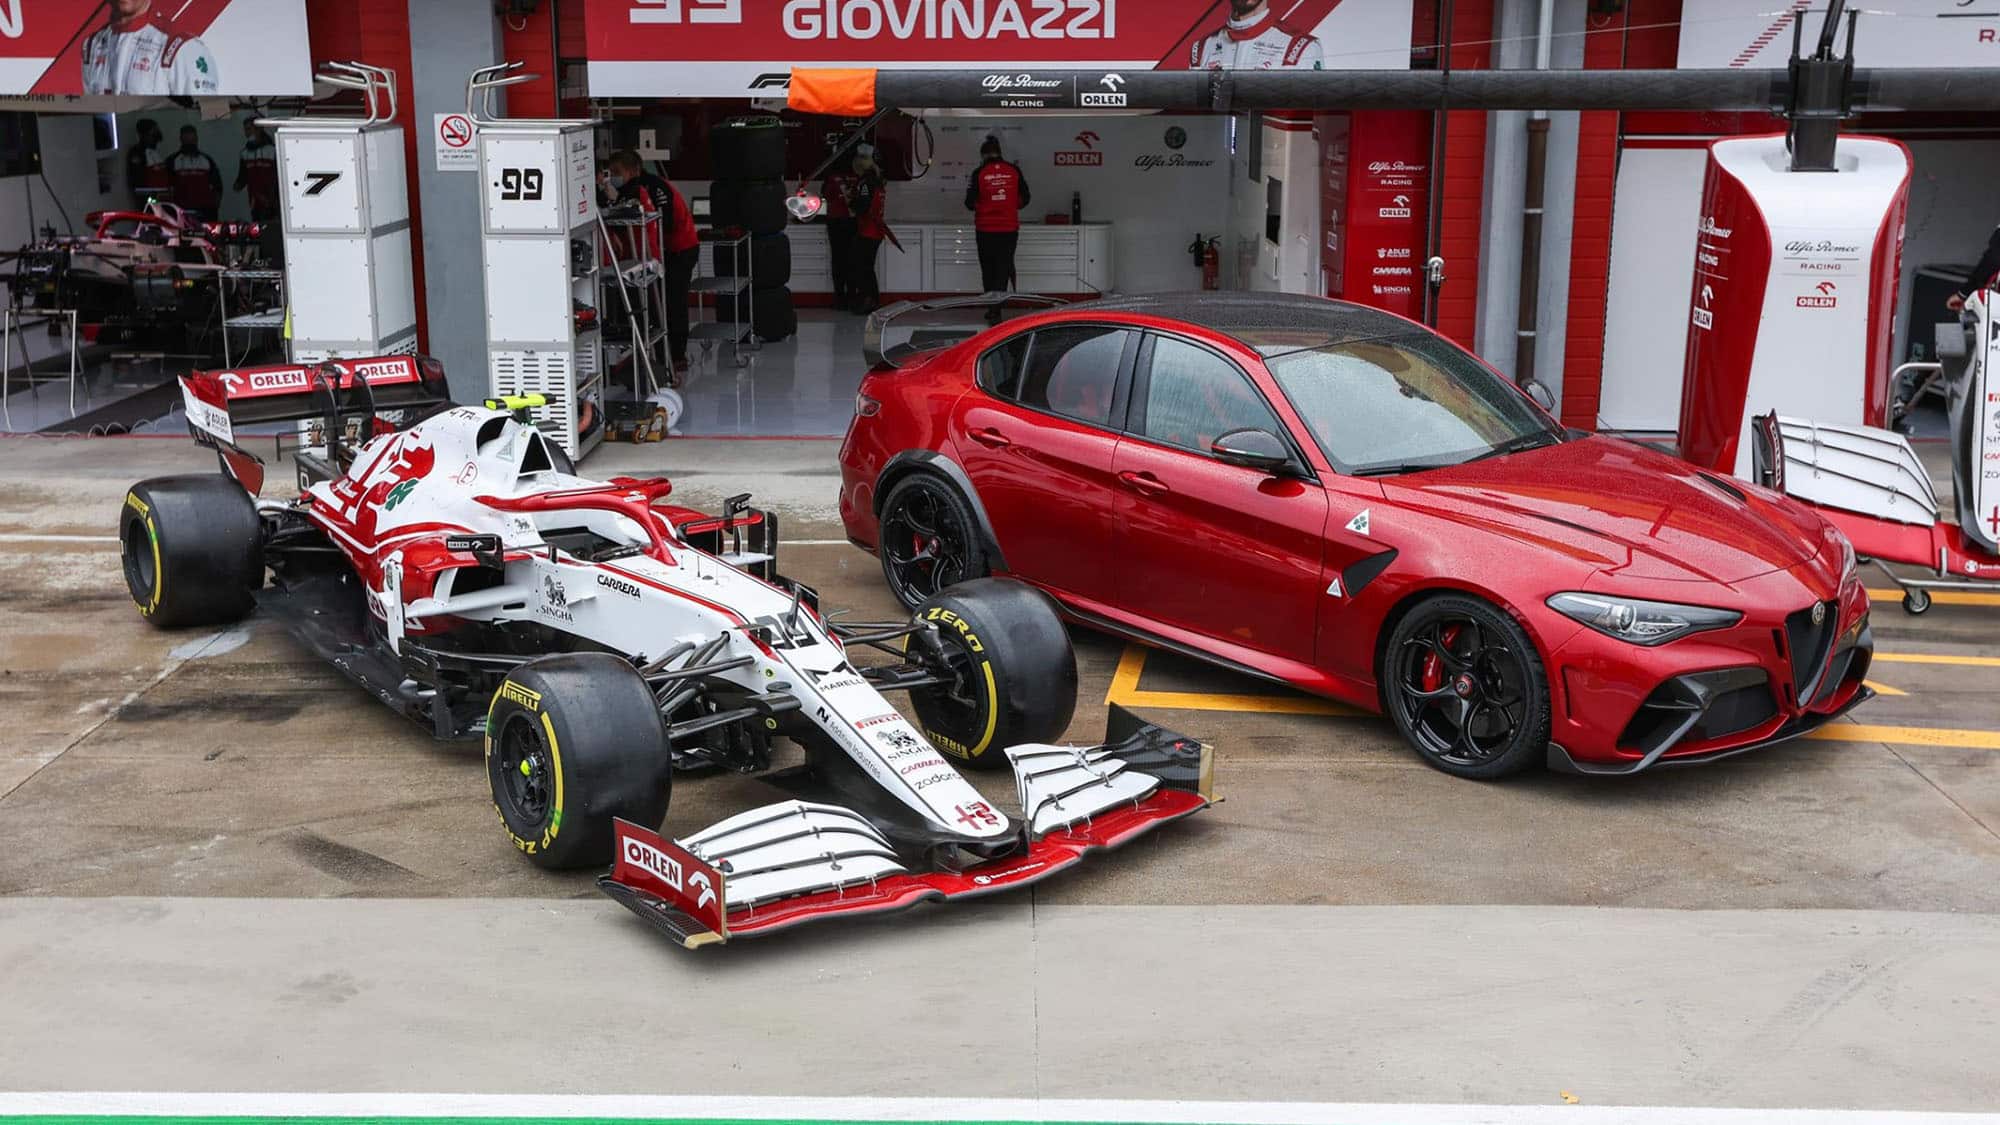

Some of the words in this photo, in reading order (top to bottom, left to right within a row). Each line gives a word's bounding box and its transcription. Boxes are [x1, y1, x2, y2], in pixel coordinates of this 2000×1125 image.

[782, 0, 1116, 39] GIOVINAZZI
[982, 75, 1013, 92] Alfa
[1014, 74, 1061, 88] Romeo
[1084, 95, 1124, 105] ORLEN
[1056, 154, 1099, 164] ORLEN
[1135, 155, 1165, 171] Alfa
[1165, 153, 1214, 167] Romeo
[304, 171, 342, 196] 7
[501, 168, 543, 200] 99
[1784, 240, 1815, 255] Alfa
[1816, 240, 1859, 252] Romeo
[360, 364, 405, 378] ORLEN
[254, 374, 301, 387] ORLEN
[597, 574, 641, 598] CARRERA
[540, 605, 574, 623] SINGHA
[928, 607, 984, 652] ZERO
[502, 680, 543, 712] PIRELLI
[855, 713, 902, 730] PIRELLI
[887, 745, 933, 762] SINGHA
[926, 729, 970, 761] PIRELLI
[900, 759, 946, 776] CARRERA
[627, 842, 679, 886] ORLEN
